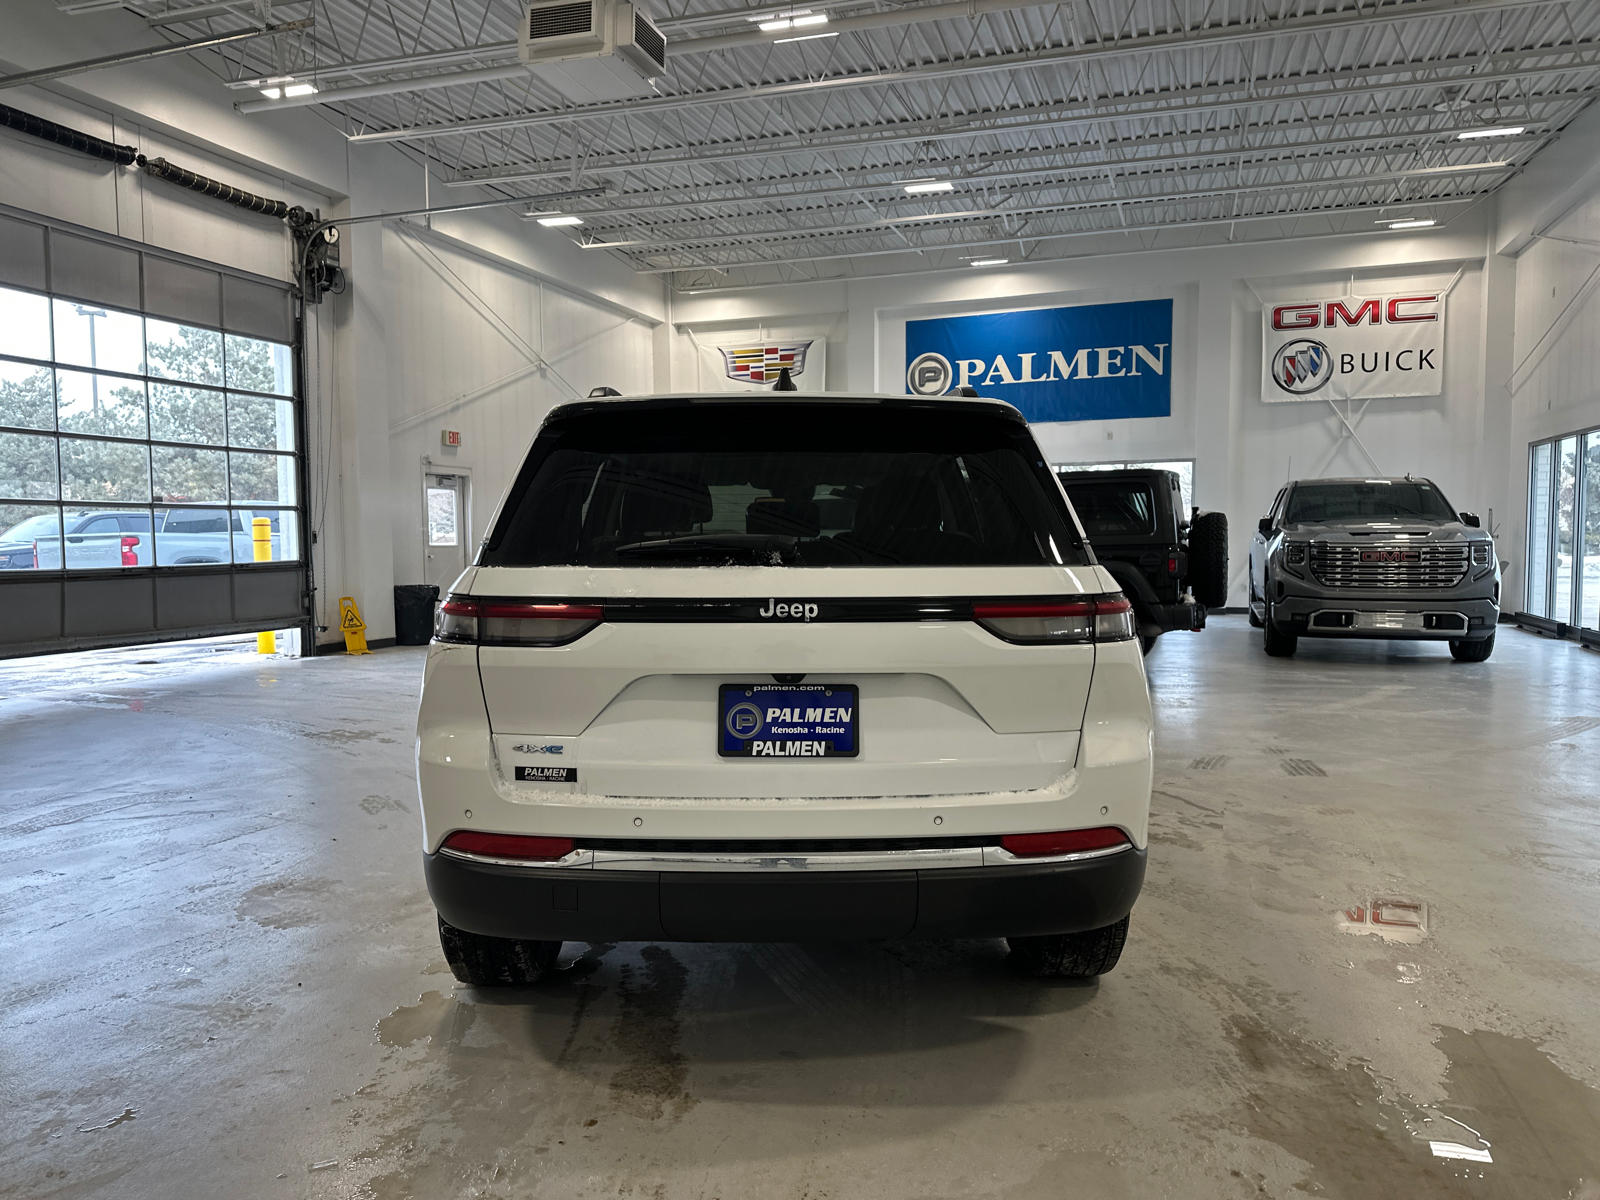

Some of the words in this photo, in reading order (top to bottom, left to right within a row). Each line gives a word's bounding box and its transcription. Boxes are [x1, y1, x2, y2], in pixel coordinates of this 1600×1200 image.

[1271, 294, 1438, 331] GMC
[955, 343, 1169, 388] PALMEN
[1340, 348, 1435, 374] BUICK
[448, 430, 459, 445] EXIT
[1362, 551, 1419, 562] GMC
[759, 598, 819, 622] Jeep
[765, 707, 852, 722] PALMEN
[771, 726, 808, 734] Kenosha
[815, 726, 845, 734] Racine
[751, 741, 826, 756] PALMEN
[524, 767, 567, 777] PALMEN
